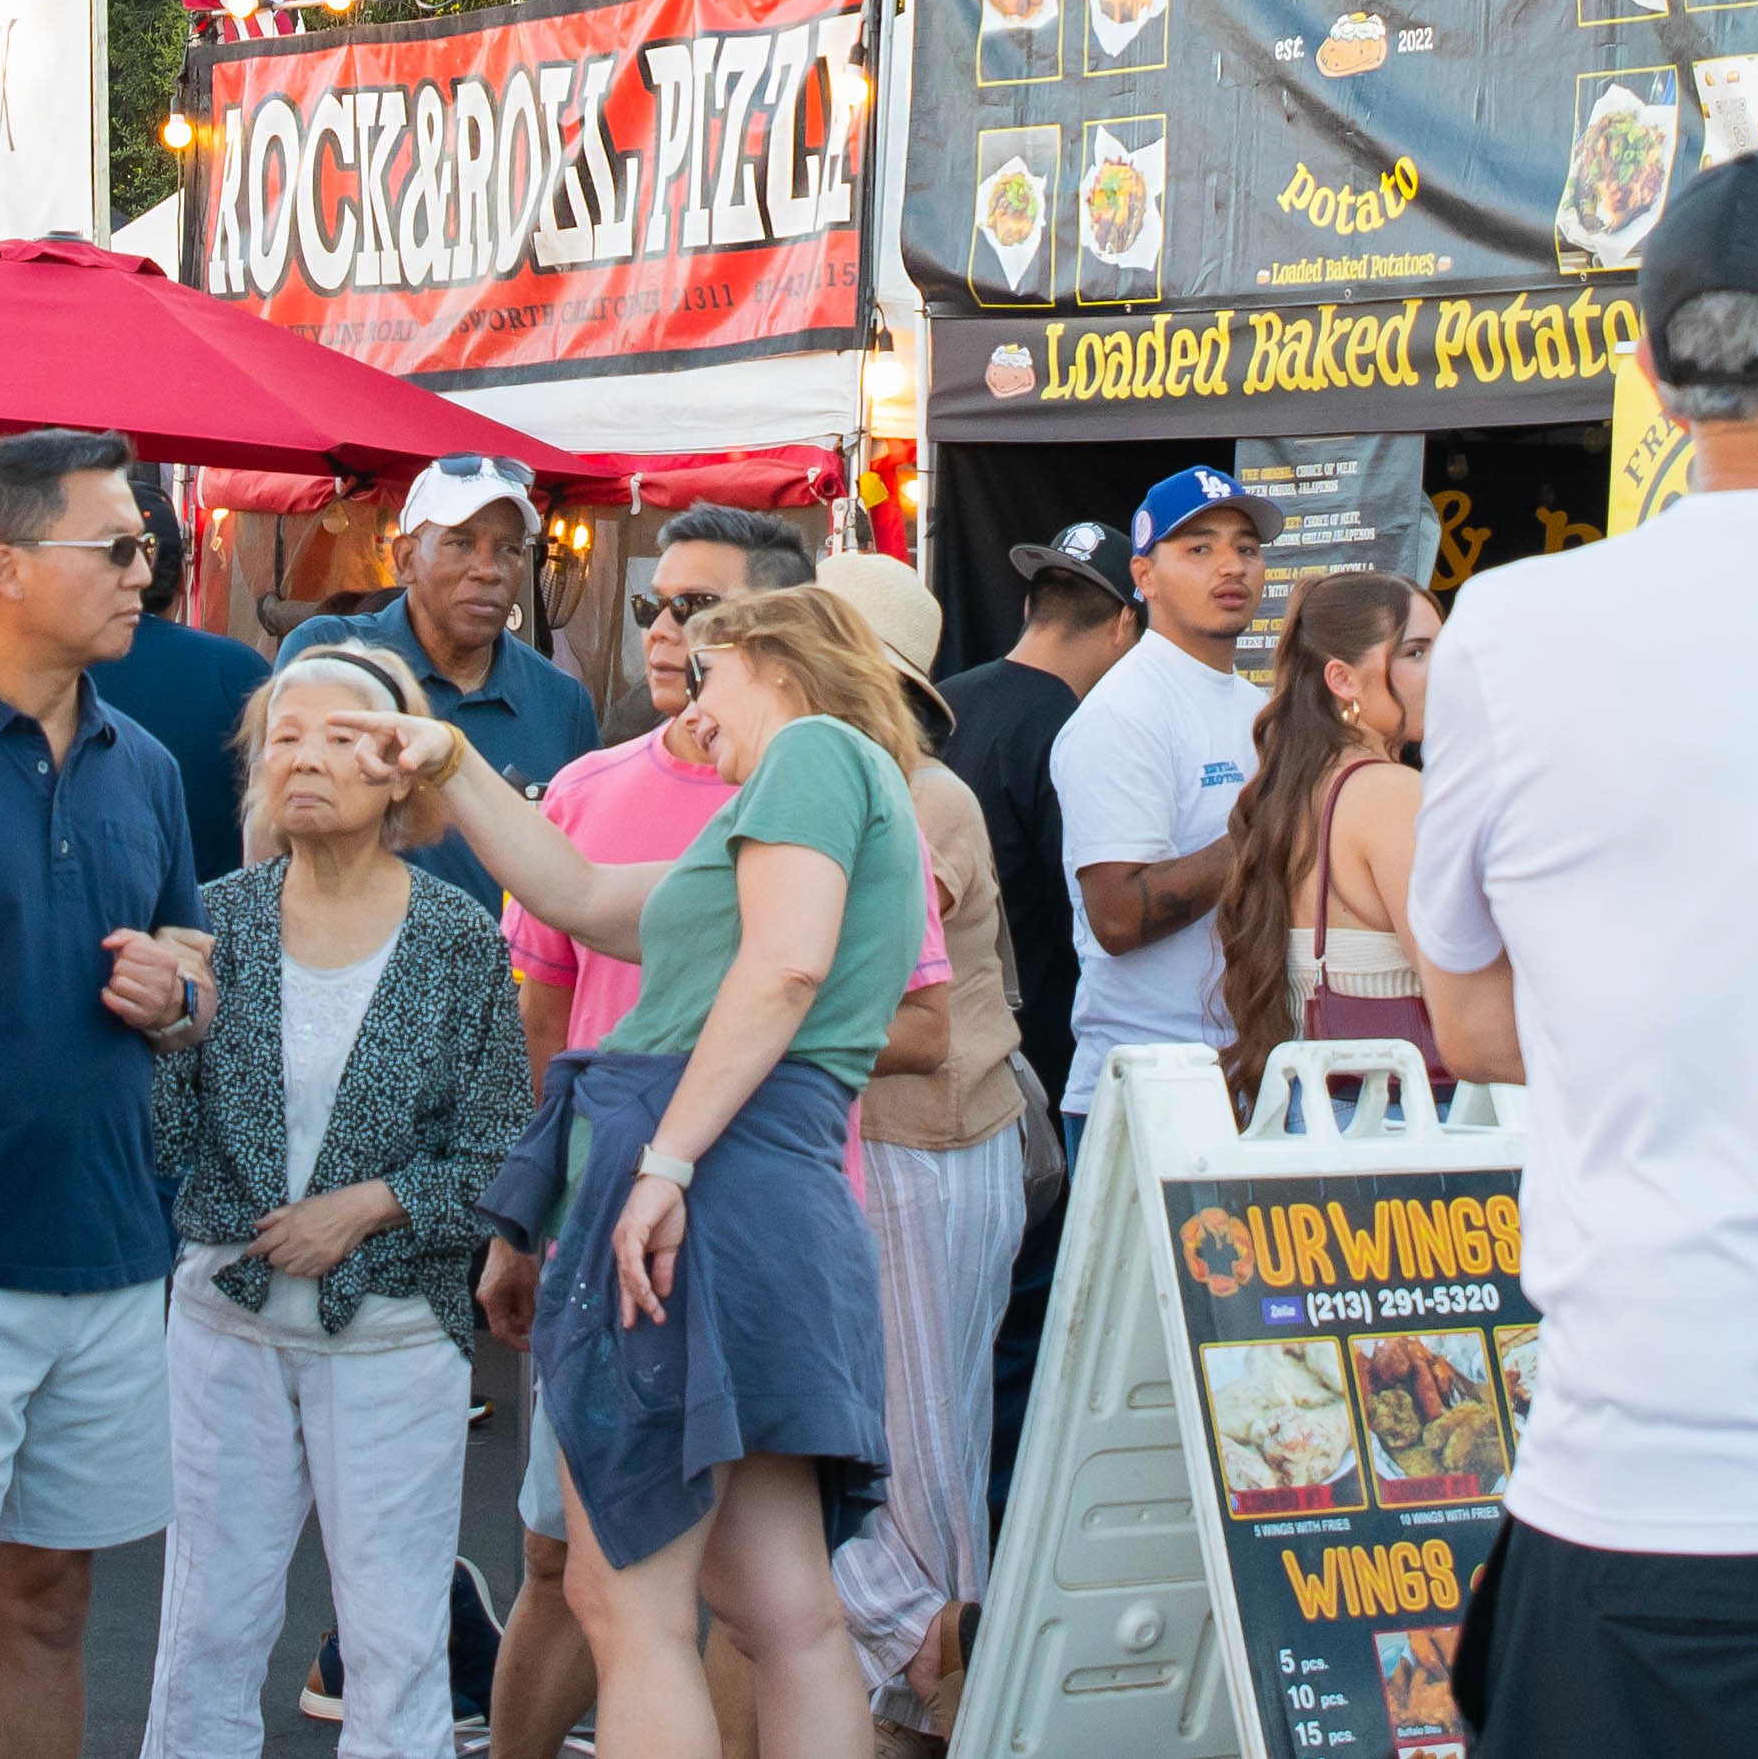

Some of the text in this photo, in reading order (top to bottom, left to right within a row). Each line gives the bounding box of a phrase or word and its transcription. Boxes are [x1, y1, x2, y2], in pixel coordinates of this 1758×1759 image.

[1397, 24, 1434, 54] 2022
[1277, 153, 1420, 236] potato
[1271, 252, 1437, 286] Loaded Baked Potatoes
[1040, 285, 1645, 403] Loaded Baked Potato
[1329, 1194, 1520, 1285] WINGS
[1305, 1290, 1374, 1326] (213)
[1377, 1283, 1500, 1319] 291-5320
[1281, 1538, 1462, 1621] WINGS
[1279, 1648, 1330, 1675] 5 pcs.
[1287, 1684, 1350, 1710] 10 pcs.
[1294, 1720, 1358, 1747] 15 pcs.
